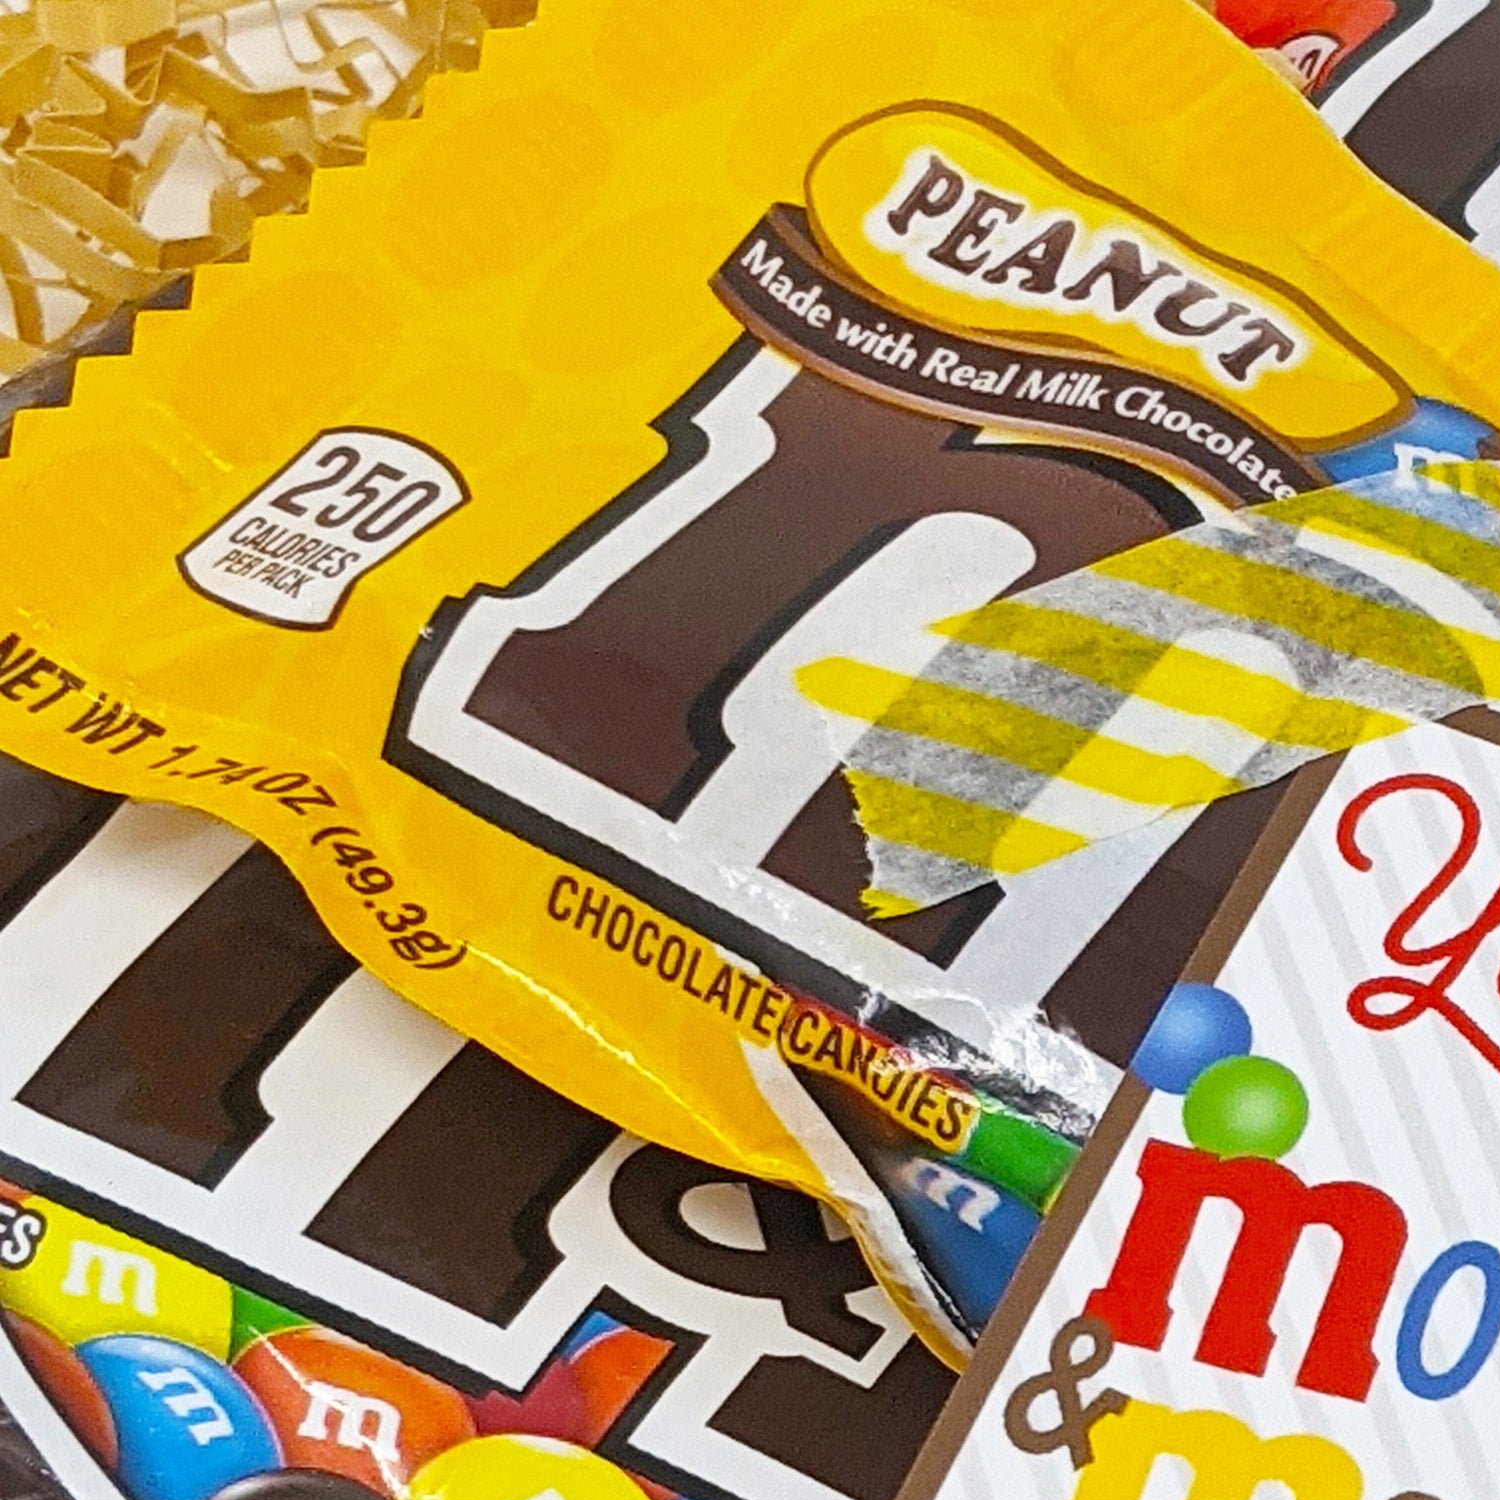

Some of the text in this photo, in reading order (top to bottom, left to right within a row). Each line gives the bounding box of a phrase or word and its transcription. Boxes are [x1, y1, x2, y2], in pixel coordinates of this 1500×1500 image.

[886, 153, 1297, 383] PEANUT
[740, 238, 1300, 502] Made with Real Milk Chocolate
[270, 445, 442, 543] 250
[213, 549, 315, 598] PER PACK
[228, 516, 361, 580] CALORIES
[0, 632, 86, 713] NET
[65, 692, 166, 755] WT
[311, 825, 468, 970] (49.3g)
[547, 874, 972, 1144] CHOCOLATE CANDIES
[60, 1239, 158, 1318] m
[137, 1365, 235, 1446] m
[297, 1378, 402, 1462] m
[1003, 1316, 1132, 1471] &
